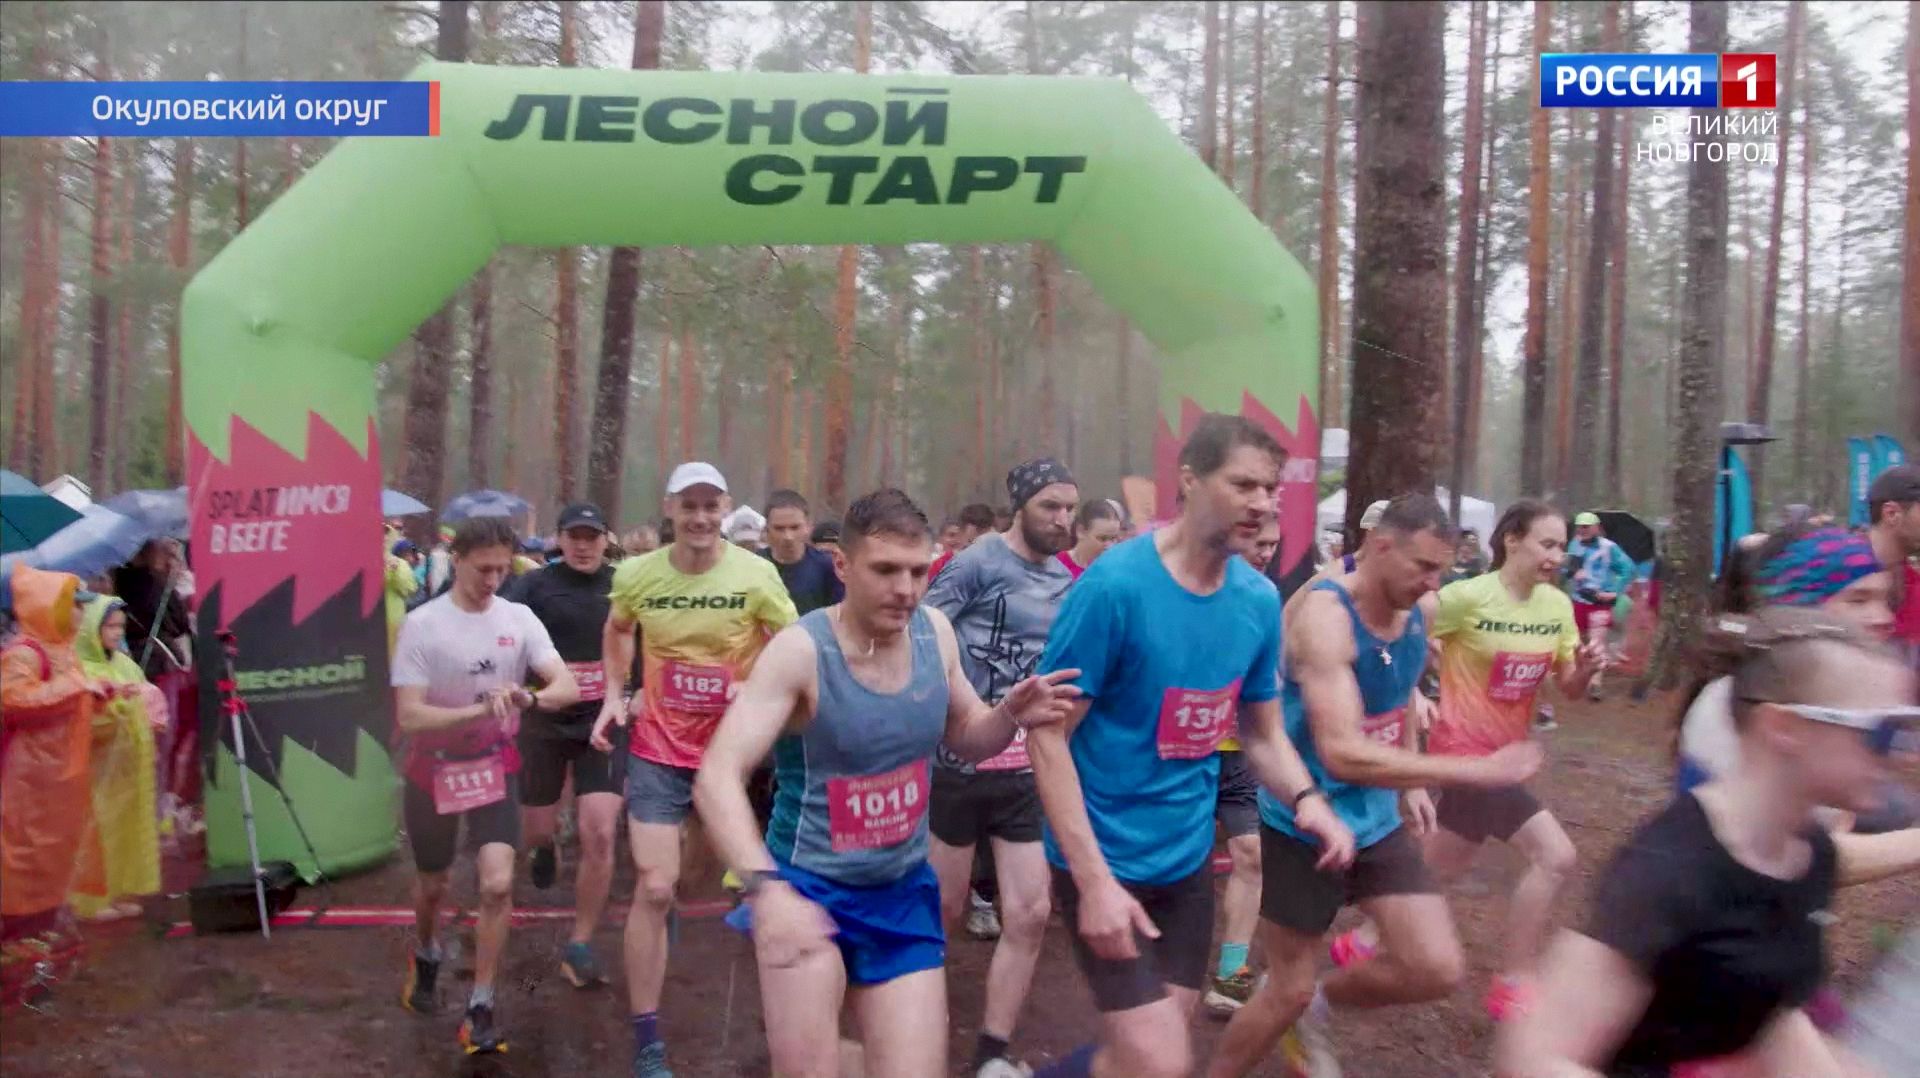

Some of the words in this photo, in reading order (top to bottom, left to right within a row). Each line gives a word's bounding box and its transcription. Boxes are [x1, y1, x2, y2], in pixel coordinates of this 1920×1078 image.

[483, 87, 950, 146] ЛЕСНОЙ
[724, 154, 1087, 206] СТАРТ
[1474, 618, 1563, 636] ЛЕСНОЙ
[672, 673, 723, 694] 1182
[443, 769, 495, 792] 1111
[845, 779, 920, 818] 1018
